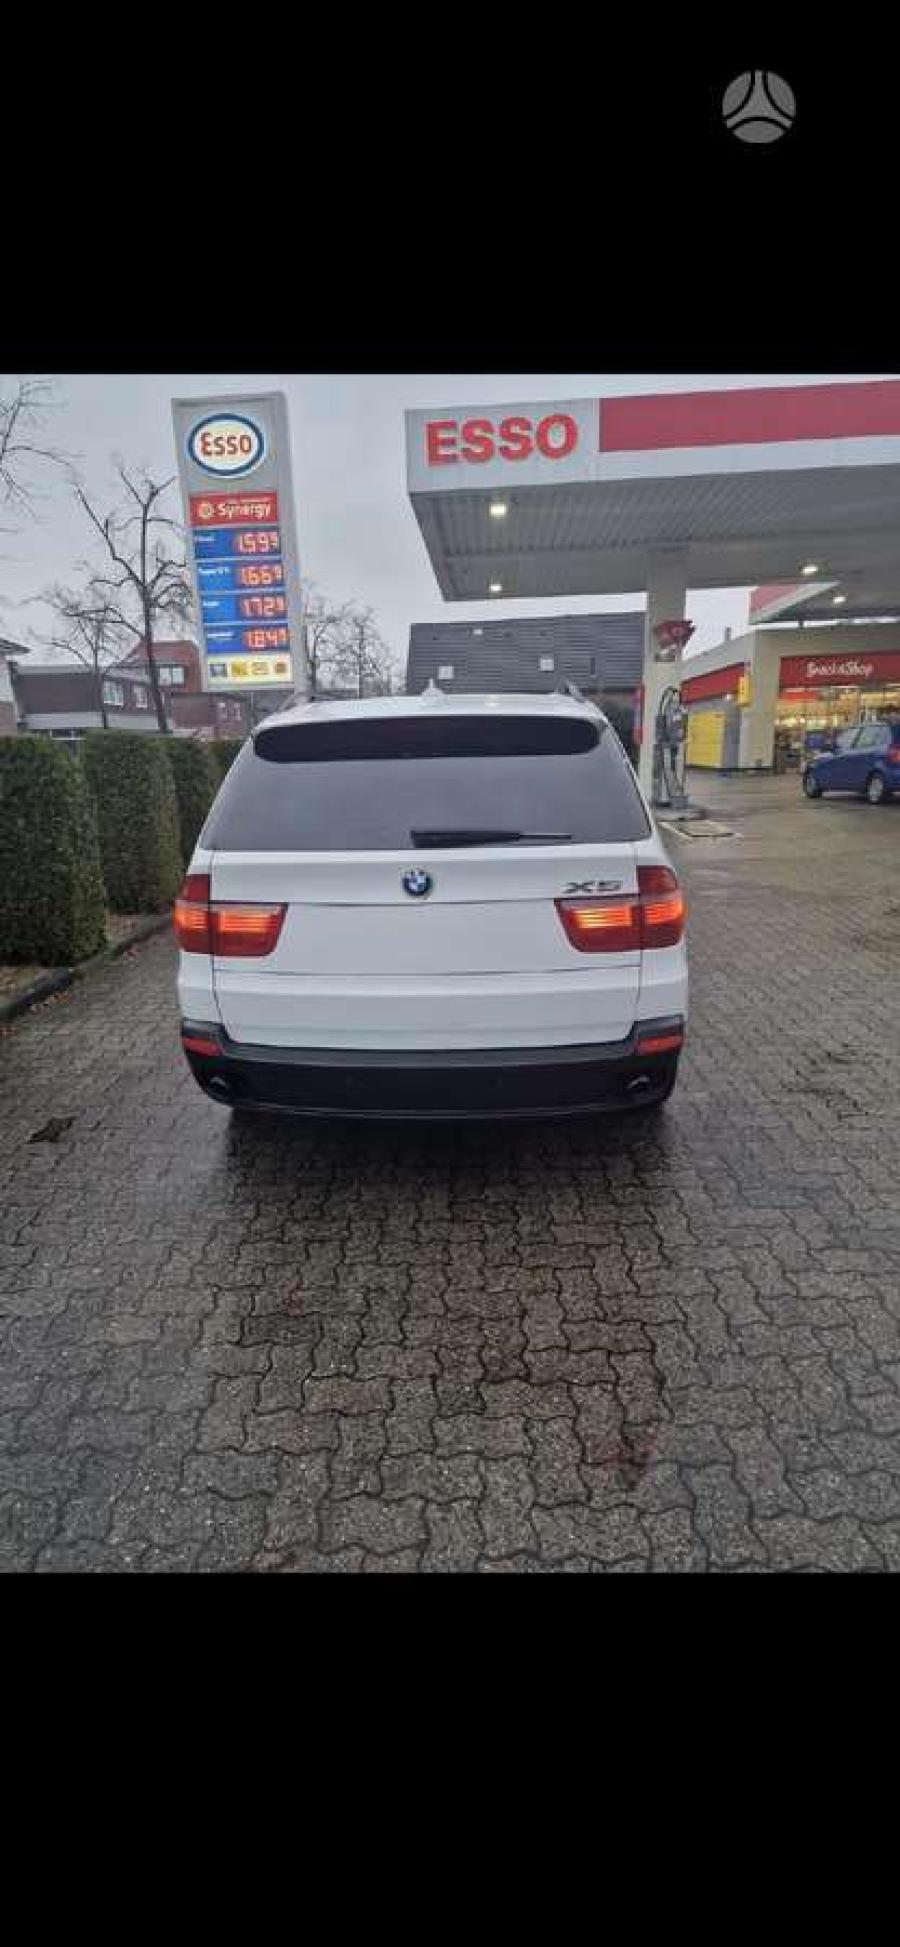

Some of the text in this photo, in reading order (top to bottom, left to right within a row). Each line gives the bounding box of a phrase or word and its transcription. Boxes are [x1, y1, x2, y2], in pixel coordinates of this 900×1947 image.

[426, 415, 577, 466] ESSO
[217, 502, 272, 520] Synergy
[562, 880, 623, 894] X5
